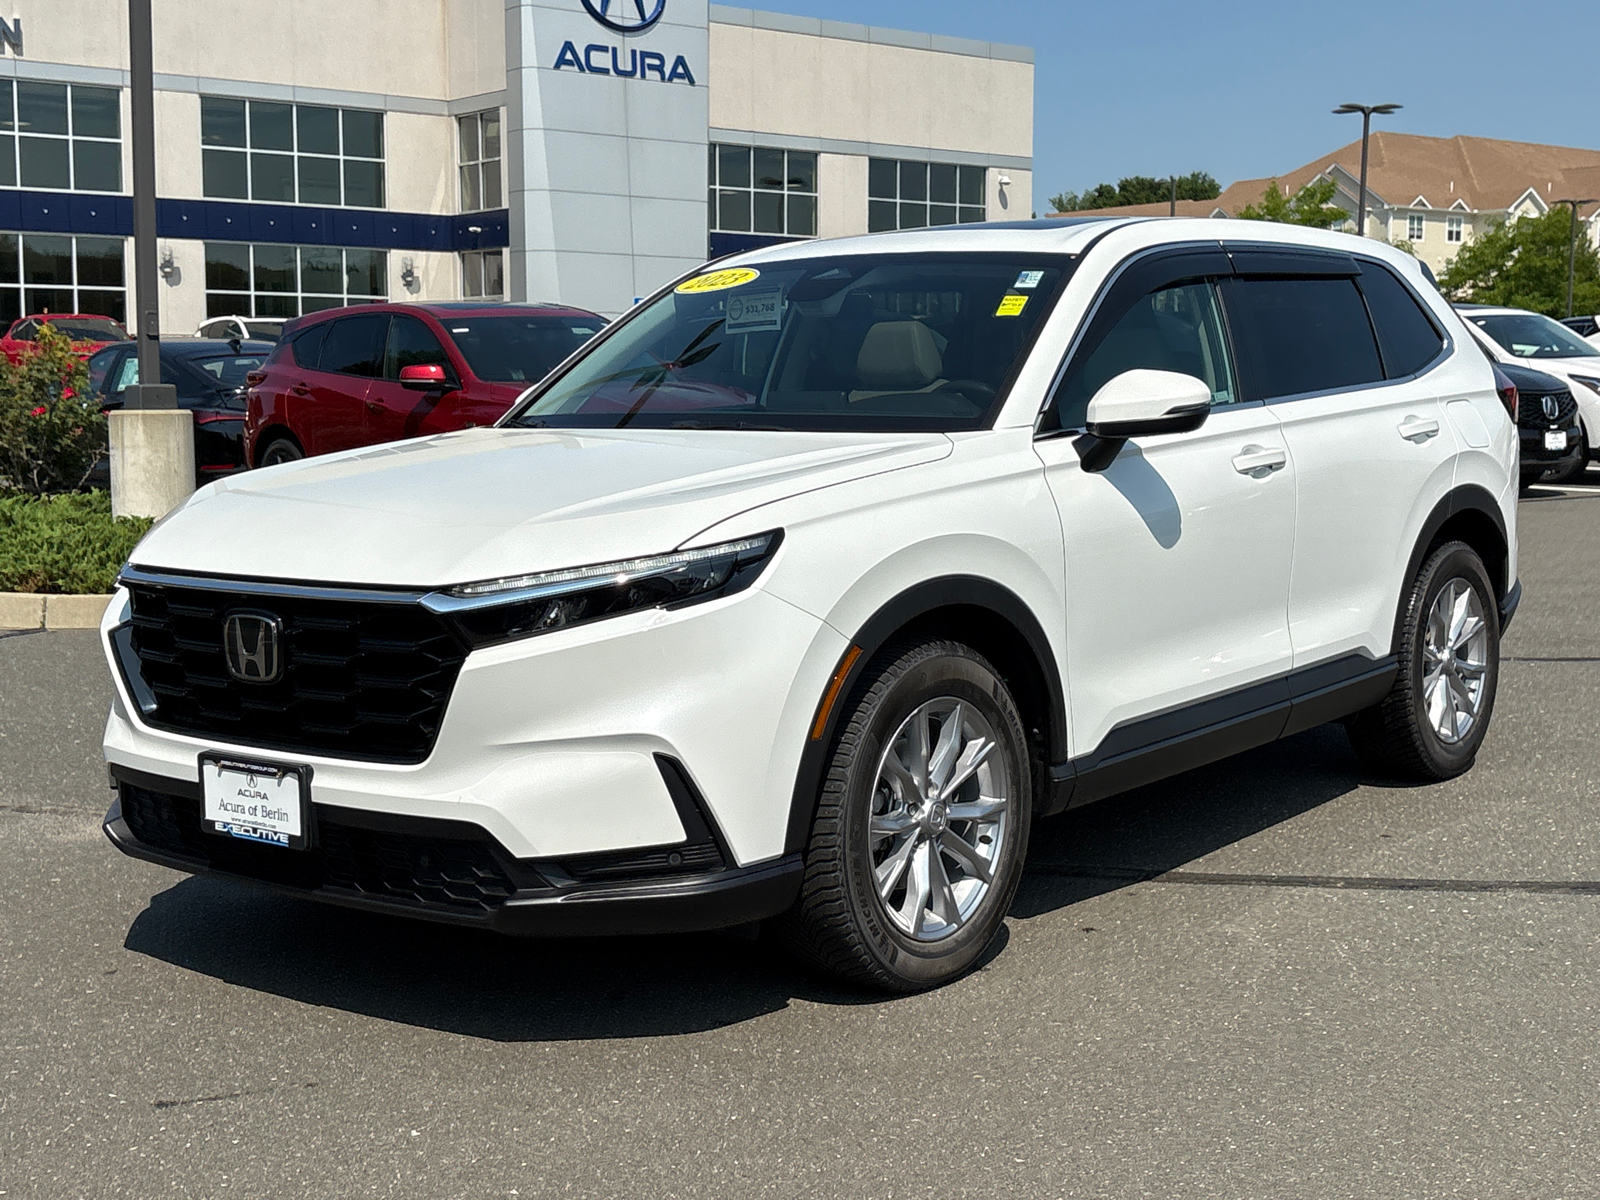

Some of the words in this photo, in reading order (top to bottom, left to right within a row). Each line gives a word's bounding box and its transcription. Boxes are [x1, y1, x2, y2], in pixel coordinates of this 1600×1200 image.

[553, 40, 696, 87] ACURA
[745, 303, 775, 314] $31,768
[237, 788, 269, 801] ACURA
[218, 798, 246, 814] Acura
[247, 804, 259, 817] of
[260, 804, 289, 822] Berlin
[214, 821, 290, 844] EXECUTIVE
